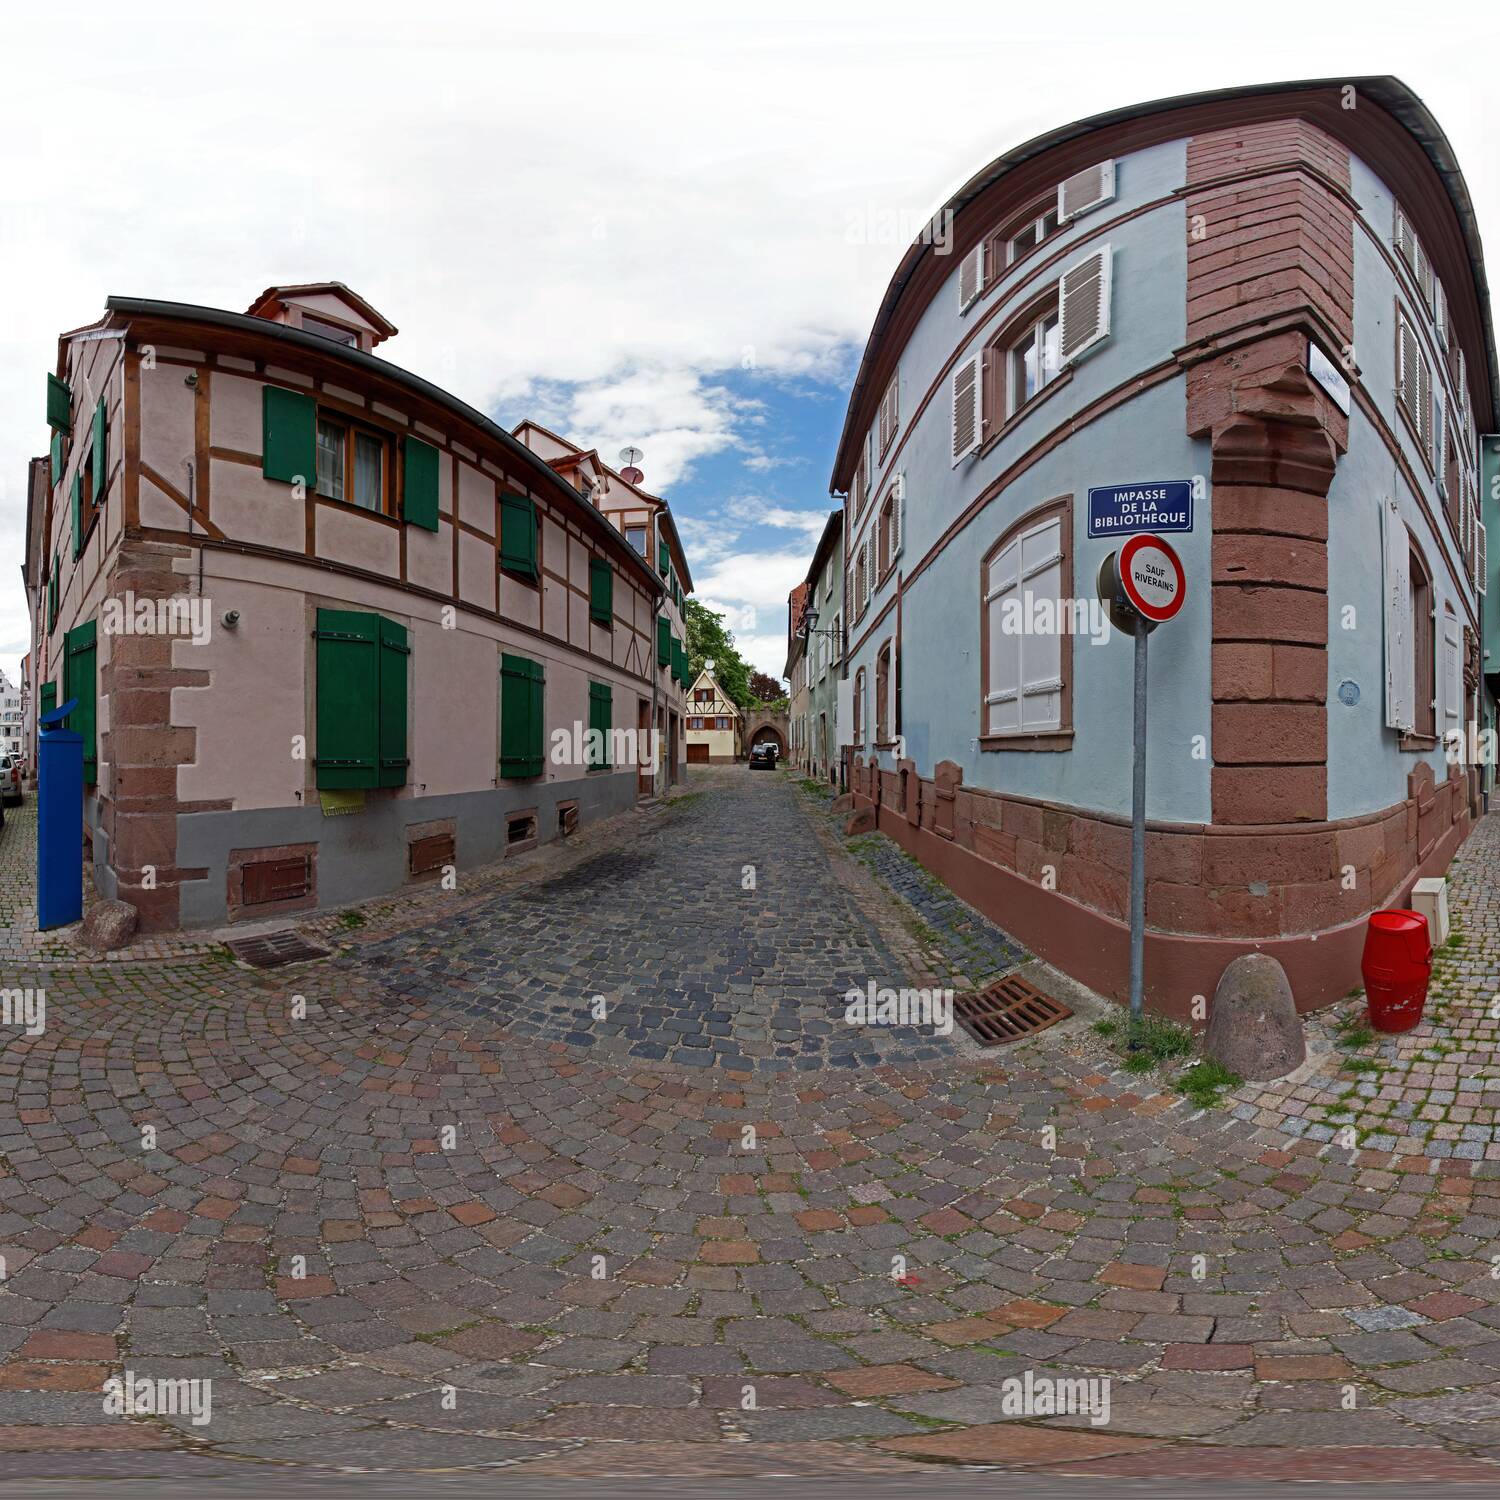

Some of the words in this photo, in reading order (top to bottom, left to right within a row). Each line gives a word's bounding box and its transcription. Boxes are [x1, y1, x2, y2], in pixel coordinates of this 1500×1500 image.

[1114, 489, 1166, 503] IMPASSE
[1121, 503, 1137, 513] DE
[1142, 502, 1157, 511] LA
[1094, 512, 1186, 528] BIBLIOTHEQUE
[1145, 563, 1166, 578] SAUF
[1134, 572, 1174, 592] RIVERAINS
